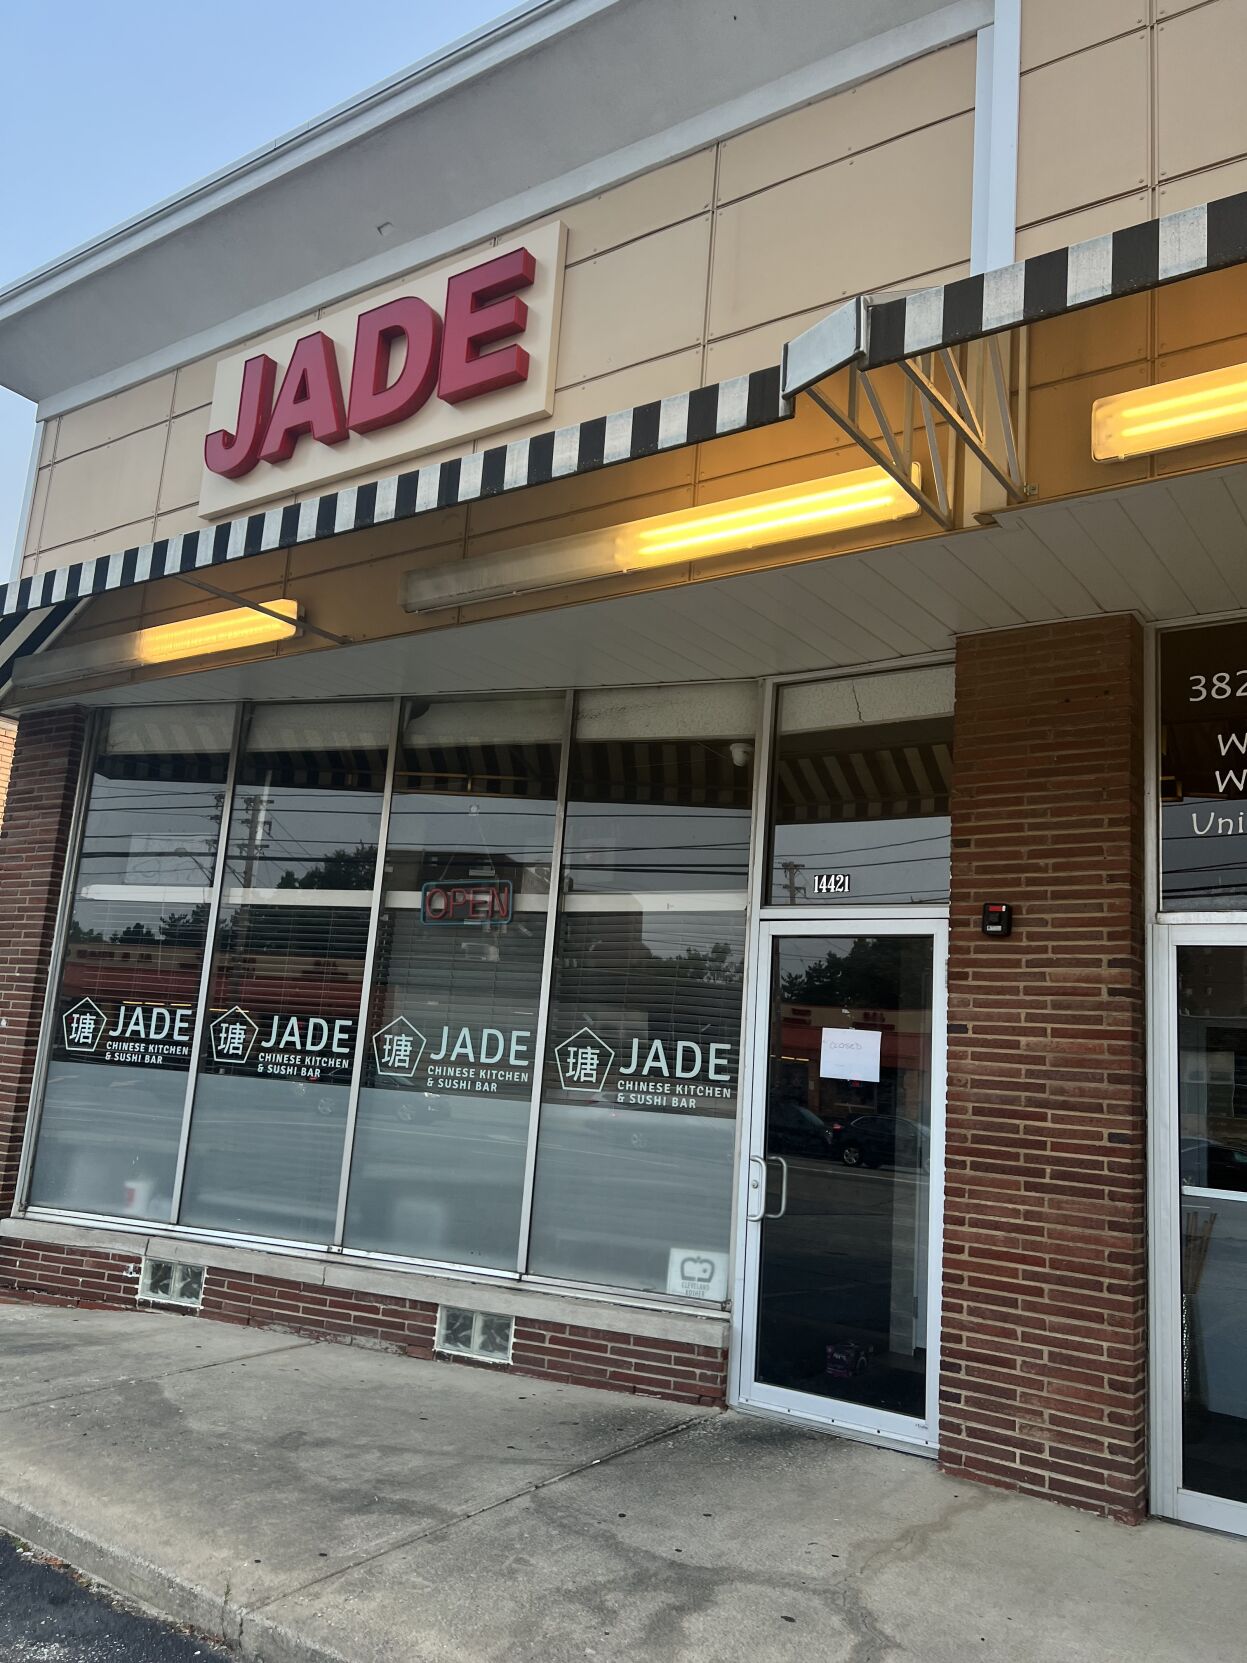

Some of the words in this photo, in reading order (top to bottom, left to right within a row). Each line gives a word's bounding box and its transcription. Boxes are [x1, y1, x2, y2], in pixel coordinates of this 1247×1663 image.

[204, 247, 537, 479] JADE
[813, 874, 850, 893] 14421
[425, 886, 509, 920] OPEN
[69, 1013, 96, 1044] 瑭
[108, 1006, 192, 1041] JADE
[217, 1022, 247, 1055] 瑭
[260, 1015, 353, 1054] JADE
[105, 1052, 112, 1060] &
[114, 1053, 142, 1062] SUSHI
[144, 1055, 163, 1064] BAR
[106, 1041, 146, 1052] CHINESE
[148, 1044, 189, 1055] KITCHEN
[258, 1052, 302, 1064] CHINESE
[304, 1056, 349, 1069] KITCHEN
[381, 1033, 414, 1069] 瑭
[429, 1025, 531, 1067] JADE
[619, 1038, 731, 1081] JADE
[257, 1063, 264, 1073] &
[267, 1064, 297, 1076] SUSHI
[300, 1067, 321, 1077] BAR
[427, 1065, 476, 1078] CHINESE
[479, 1069, 529, 1082] KITCHEN
[565, 1046, 600, 1083] 瑭
[426, 1077, 434, 1088] &
[437, 1078, 471, 1090] SUSHI
[475, 1081, 498, 1092] BAR
[617, 1080, 671, 1094] CHINESE
[675, 1084, 731, 1099] KITCHEN
[616, 1092, 626, 1103] &
[629, 1093, 667, 1107] SUSHI
[671, 1097, 697, 1109] BAR
